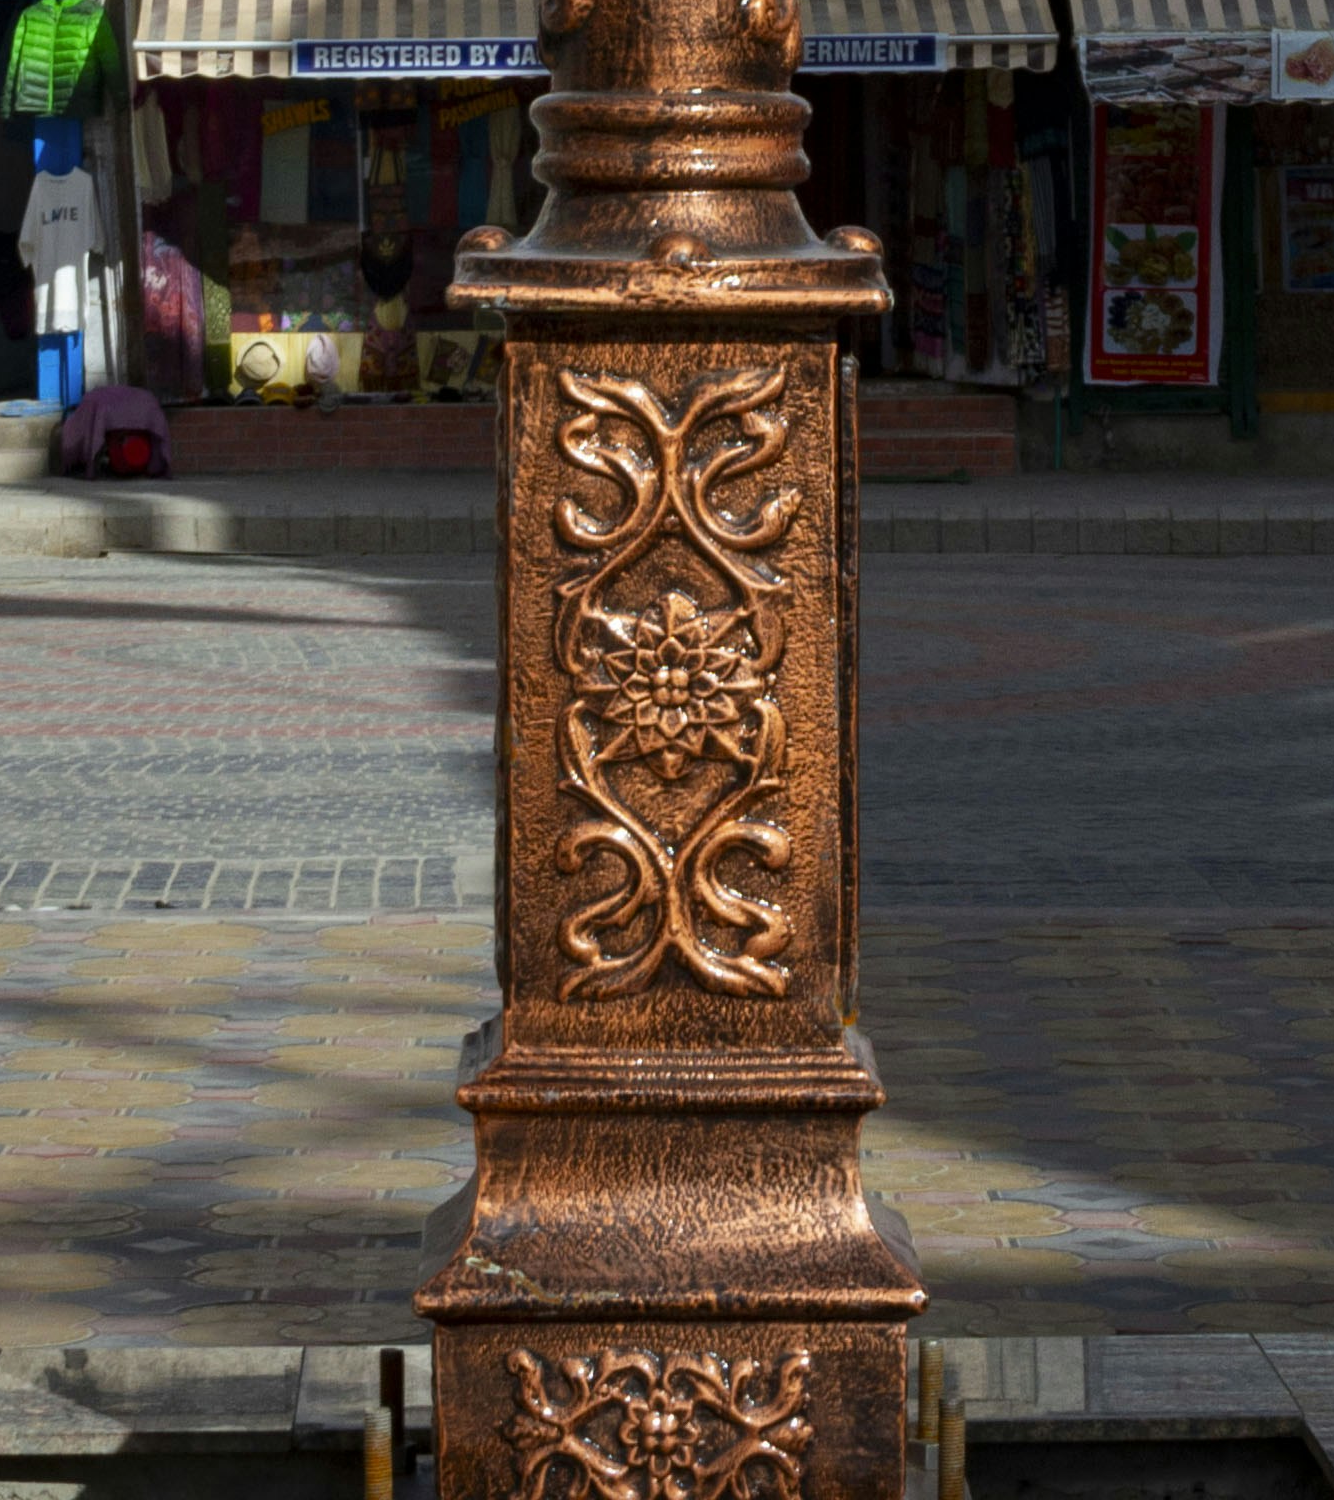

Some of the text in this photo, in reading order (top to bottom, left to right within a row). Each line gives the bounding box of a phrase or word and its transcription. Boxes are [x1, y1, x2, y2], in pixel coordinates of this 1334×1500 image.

[313, 43, 545, 69] REGISTERED BY JA
[803, 39, 919, 63] ERNMENT
[261, 98, 332, 137] SHAWLS
